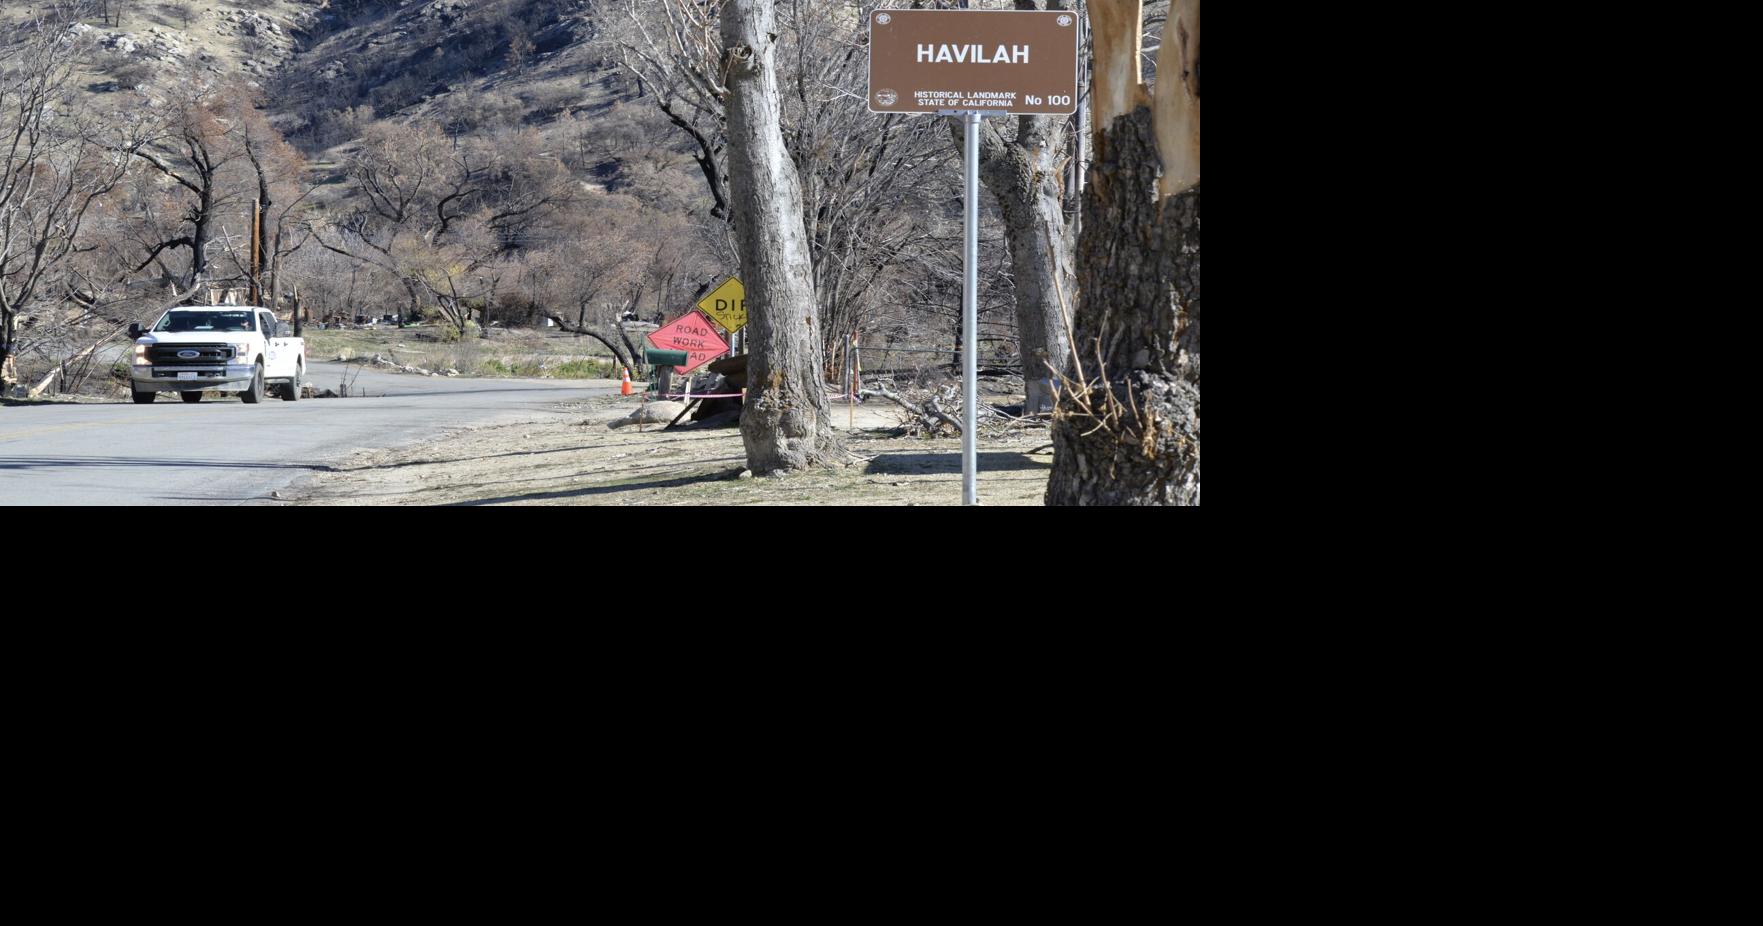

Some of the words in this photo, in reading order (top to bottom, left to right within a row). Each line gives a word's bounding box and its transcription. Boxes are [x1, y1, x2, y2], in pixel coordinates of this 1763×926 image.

[917, 43, 1029, 64] HAVILAH
[914, 91, 964, 99] HISTORICAL
[1025, 95, 1042, 105] No
[1047, 95, 1071, 106] 100
[962, 99, 1013, 107] CALIFORNIA
[676, 324, 708, 337] ROAD
[673, 336, 705, 349] WORK
